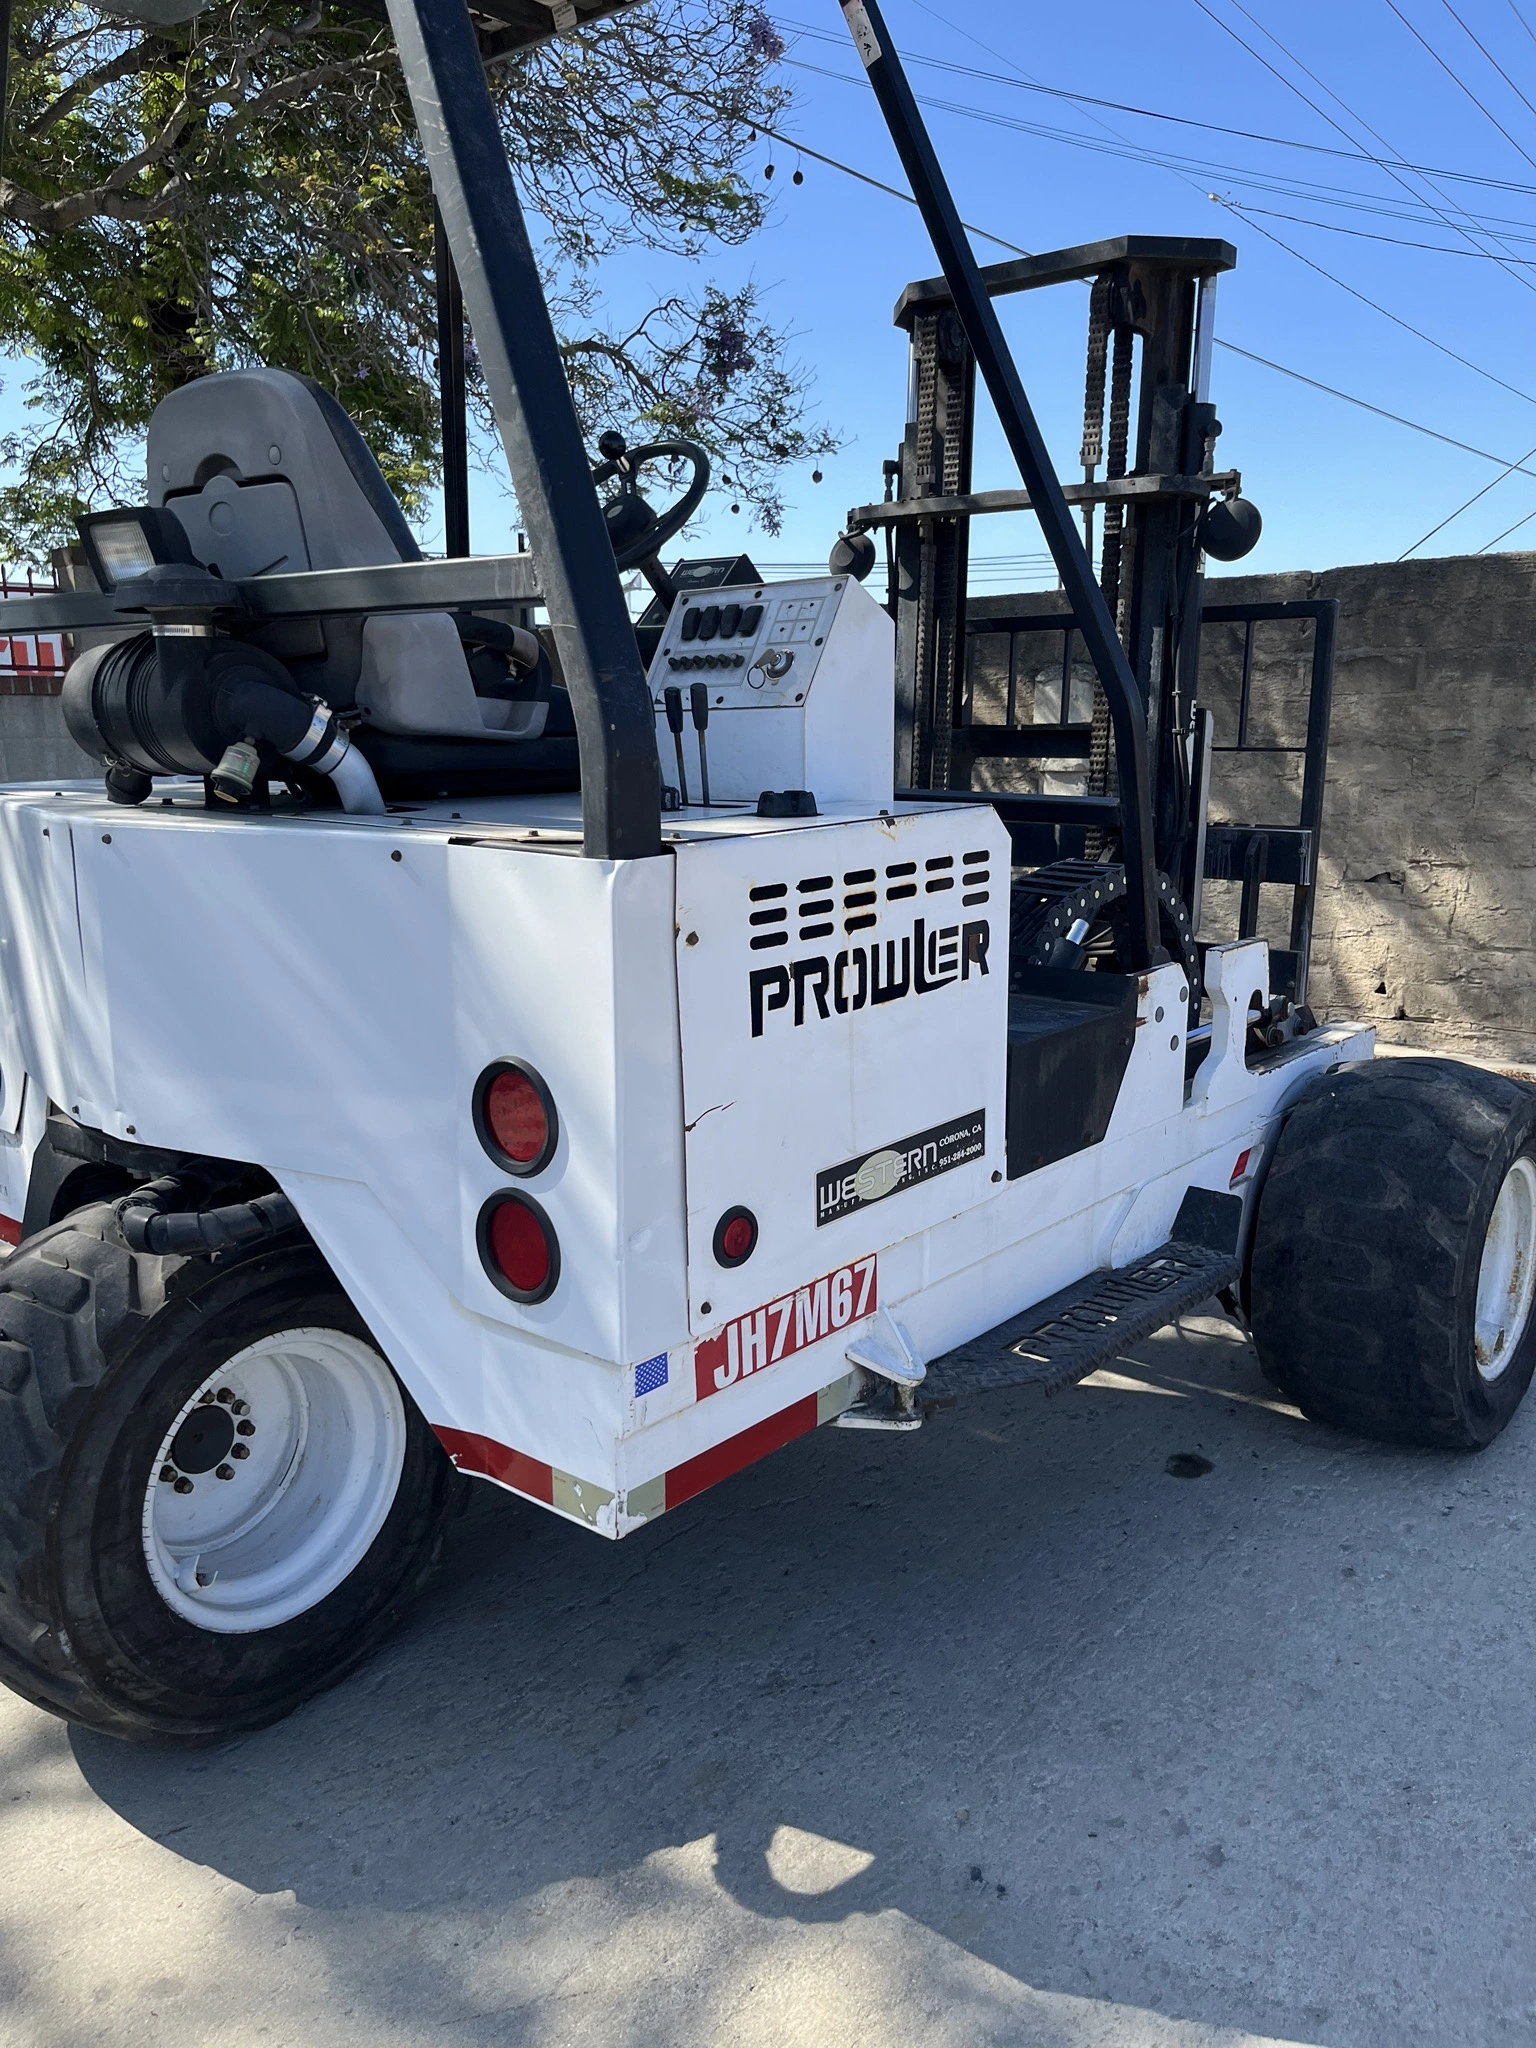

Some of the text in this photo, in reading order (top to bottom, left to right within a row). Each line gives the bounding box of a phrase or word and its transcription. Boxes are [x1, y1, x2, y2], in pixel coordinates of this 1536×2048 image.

[749, 918, 990, 1038] PROWLER
[820, 1142, 937, 1211] WESTERN
[939, 1124, 982, 1147] CORONA, CA
[713, 1255, 876, 1390] JH7M67
